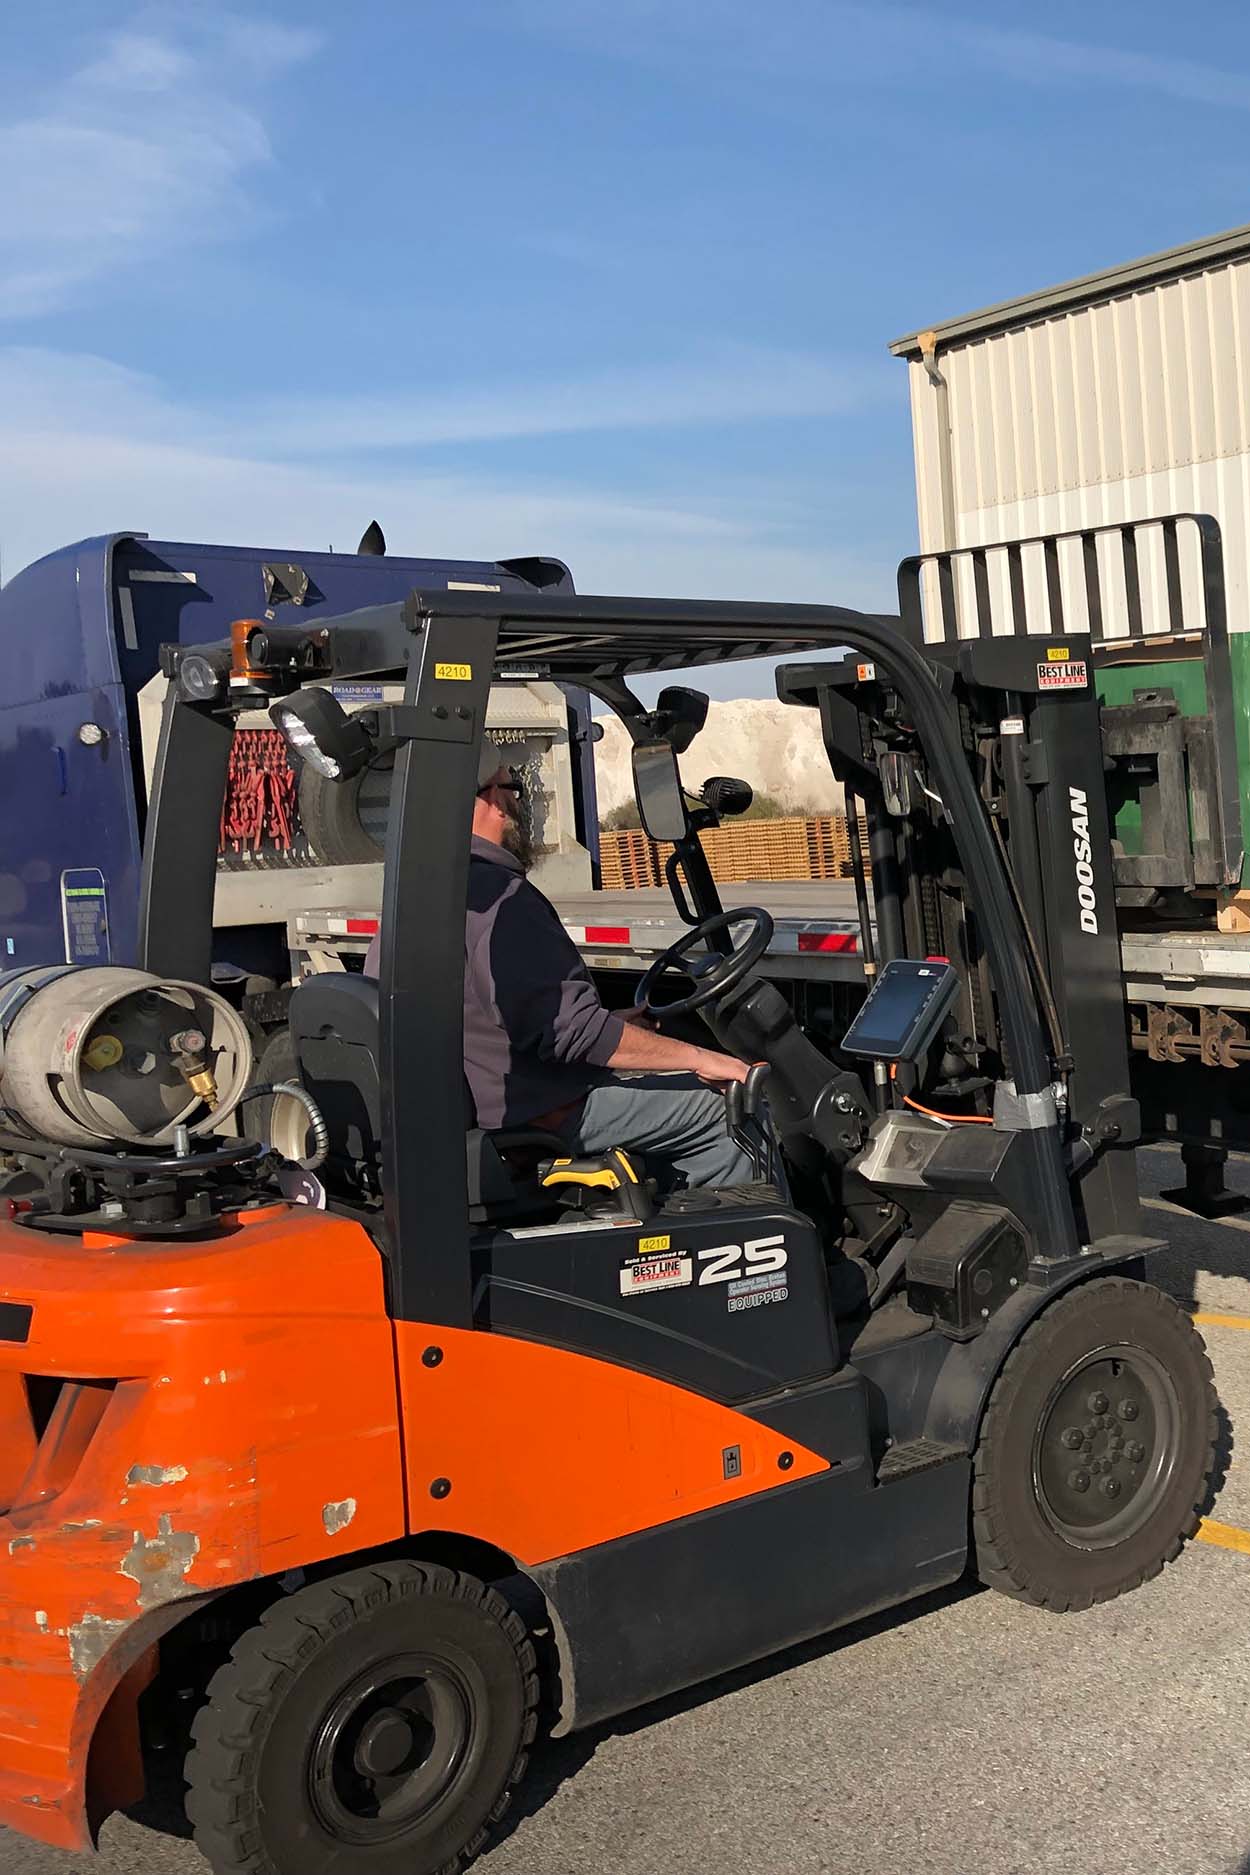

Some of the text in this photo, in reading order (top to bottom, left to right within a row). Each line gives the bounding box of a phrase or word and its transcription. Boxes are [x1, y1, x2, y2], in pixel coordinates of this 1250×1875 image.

[1050, 650, 1067, 659] 4210
[438, 666, 467, 678] 4210
[1039, 664, 1085, 678] BEST LINE
[1069, 786, 1098, 935] DOOSAN
[643, 1238, 668, 1250] 4210
[648, 1251, 677, 1261] Serviced
[697, 1234, 788, 1286] 25
[633, 1260, 680, 1277] BEST LINE
[634, 1270, 680, 1282] EQUIPMENT
[728, 1288, 788, 1313] EQUIPPED
